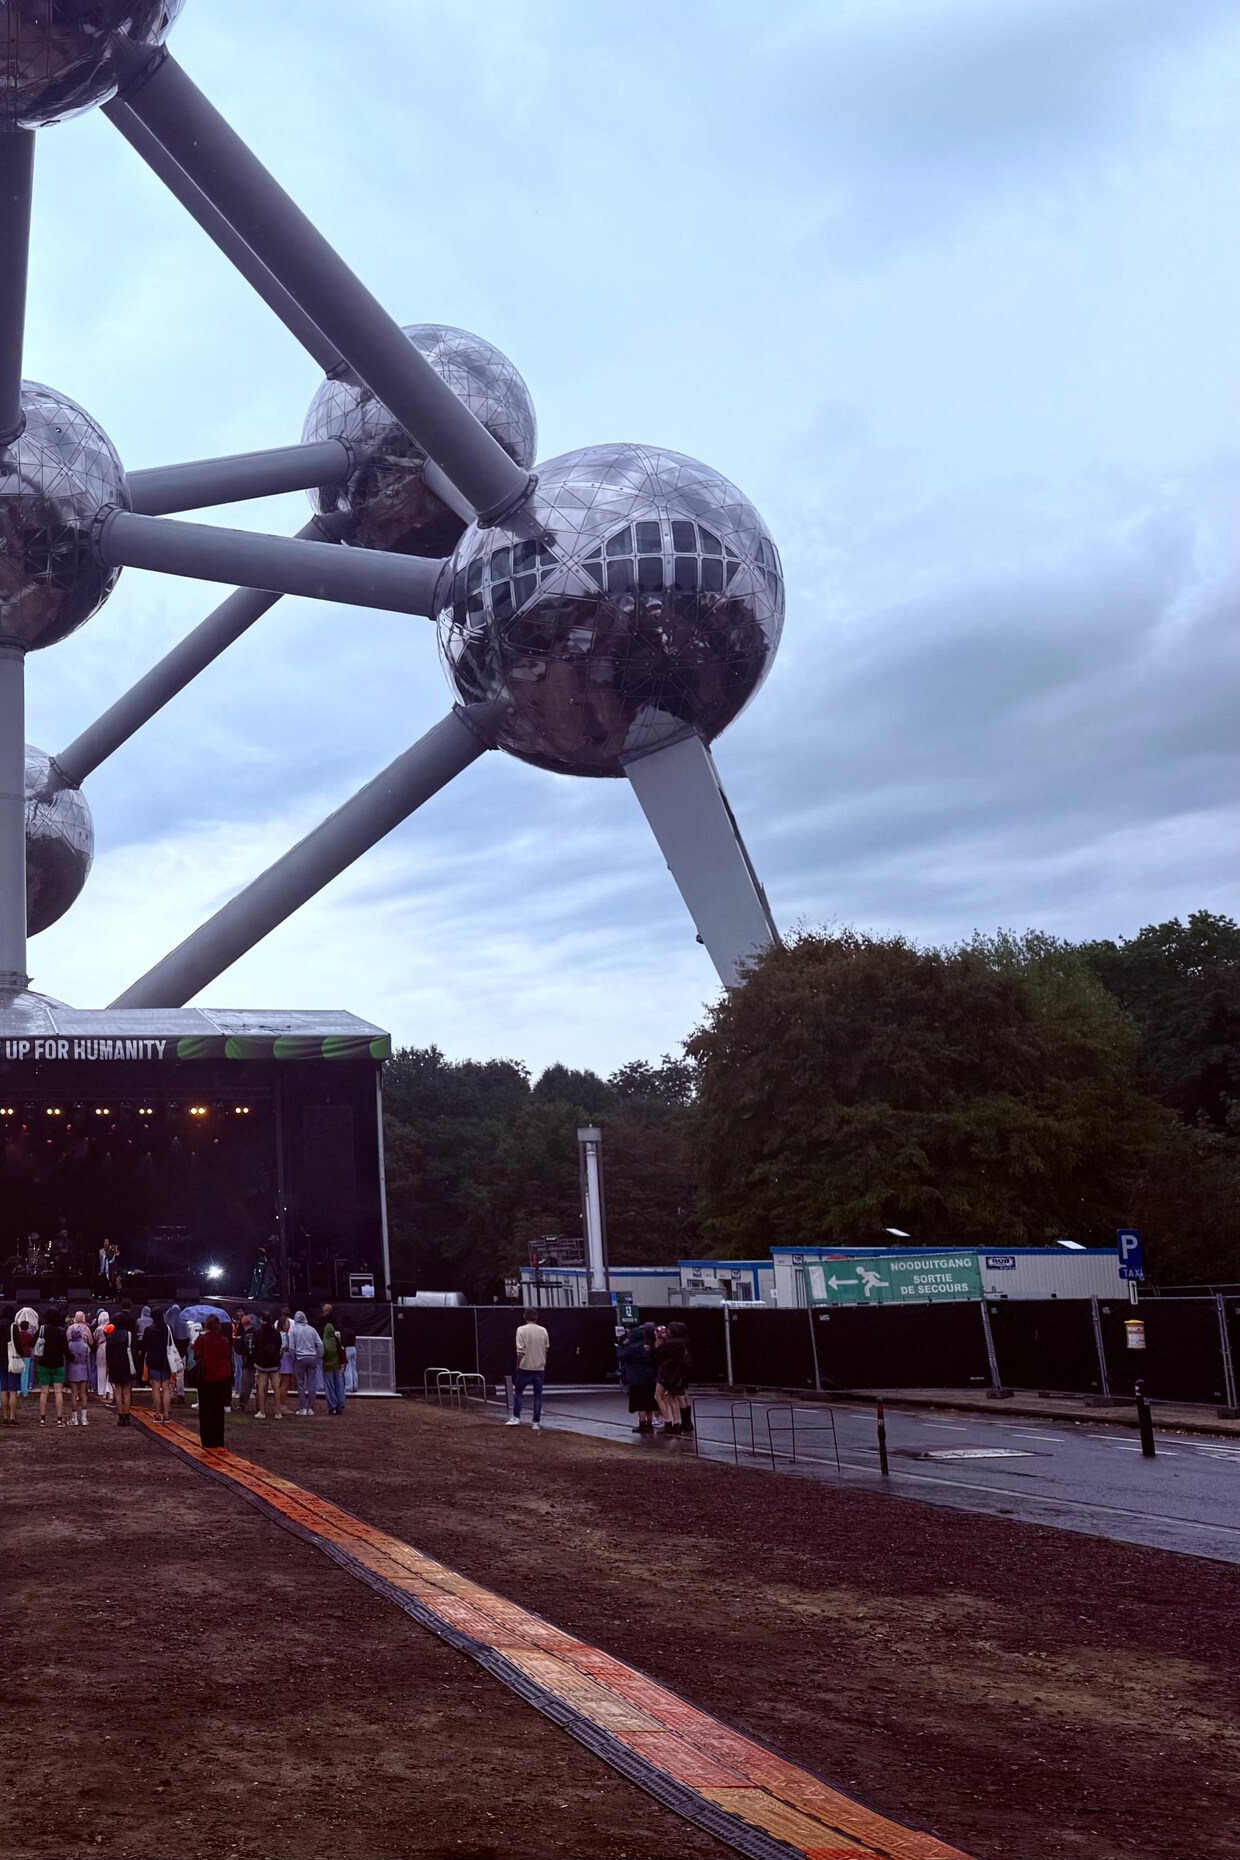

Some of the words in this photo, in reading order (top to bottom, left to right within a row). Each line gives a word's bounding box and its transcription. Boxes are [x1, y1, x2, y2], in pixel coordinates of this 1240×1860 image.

[5, 1040, 30, 1060] UP
[34, 1039, 69, 1060] FOR
[73, 1039, 167, 1061] HUMANITY
[1121, 1234, 1138, 1260] P
[890, 1258, 972, 1271] NOODUITGANG
[913, 1273, 953, 1284] SORTIE
[1122, 1268, 1144, 1278] TAXI
[900, 1285, 916, 1295] DE
[918, 1282, 969, 1294] SECOURS
